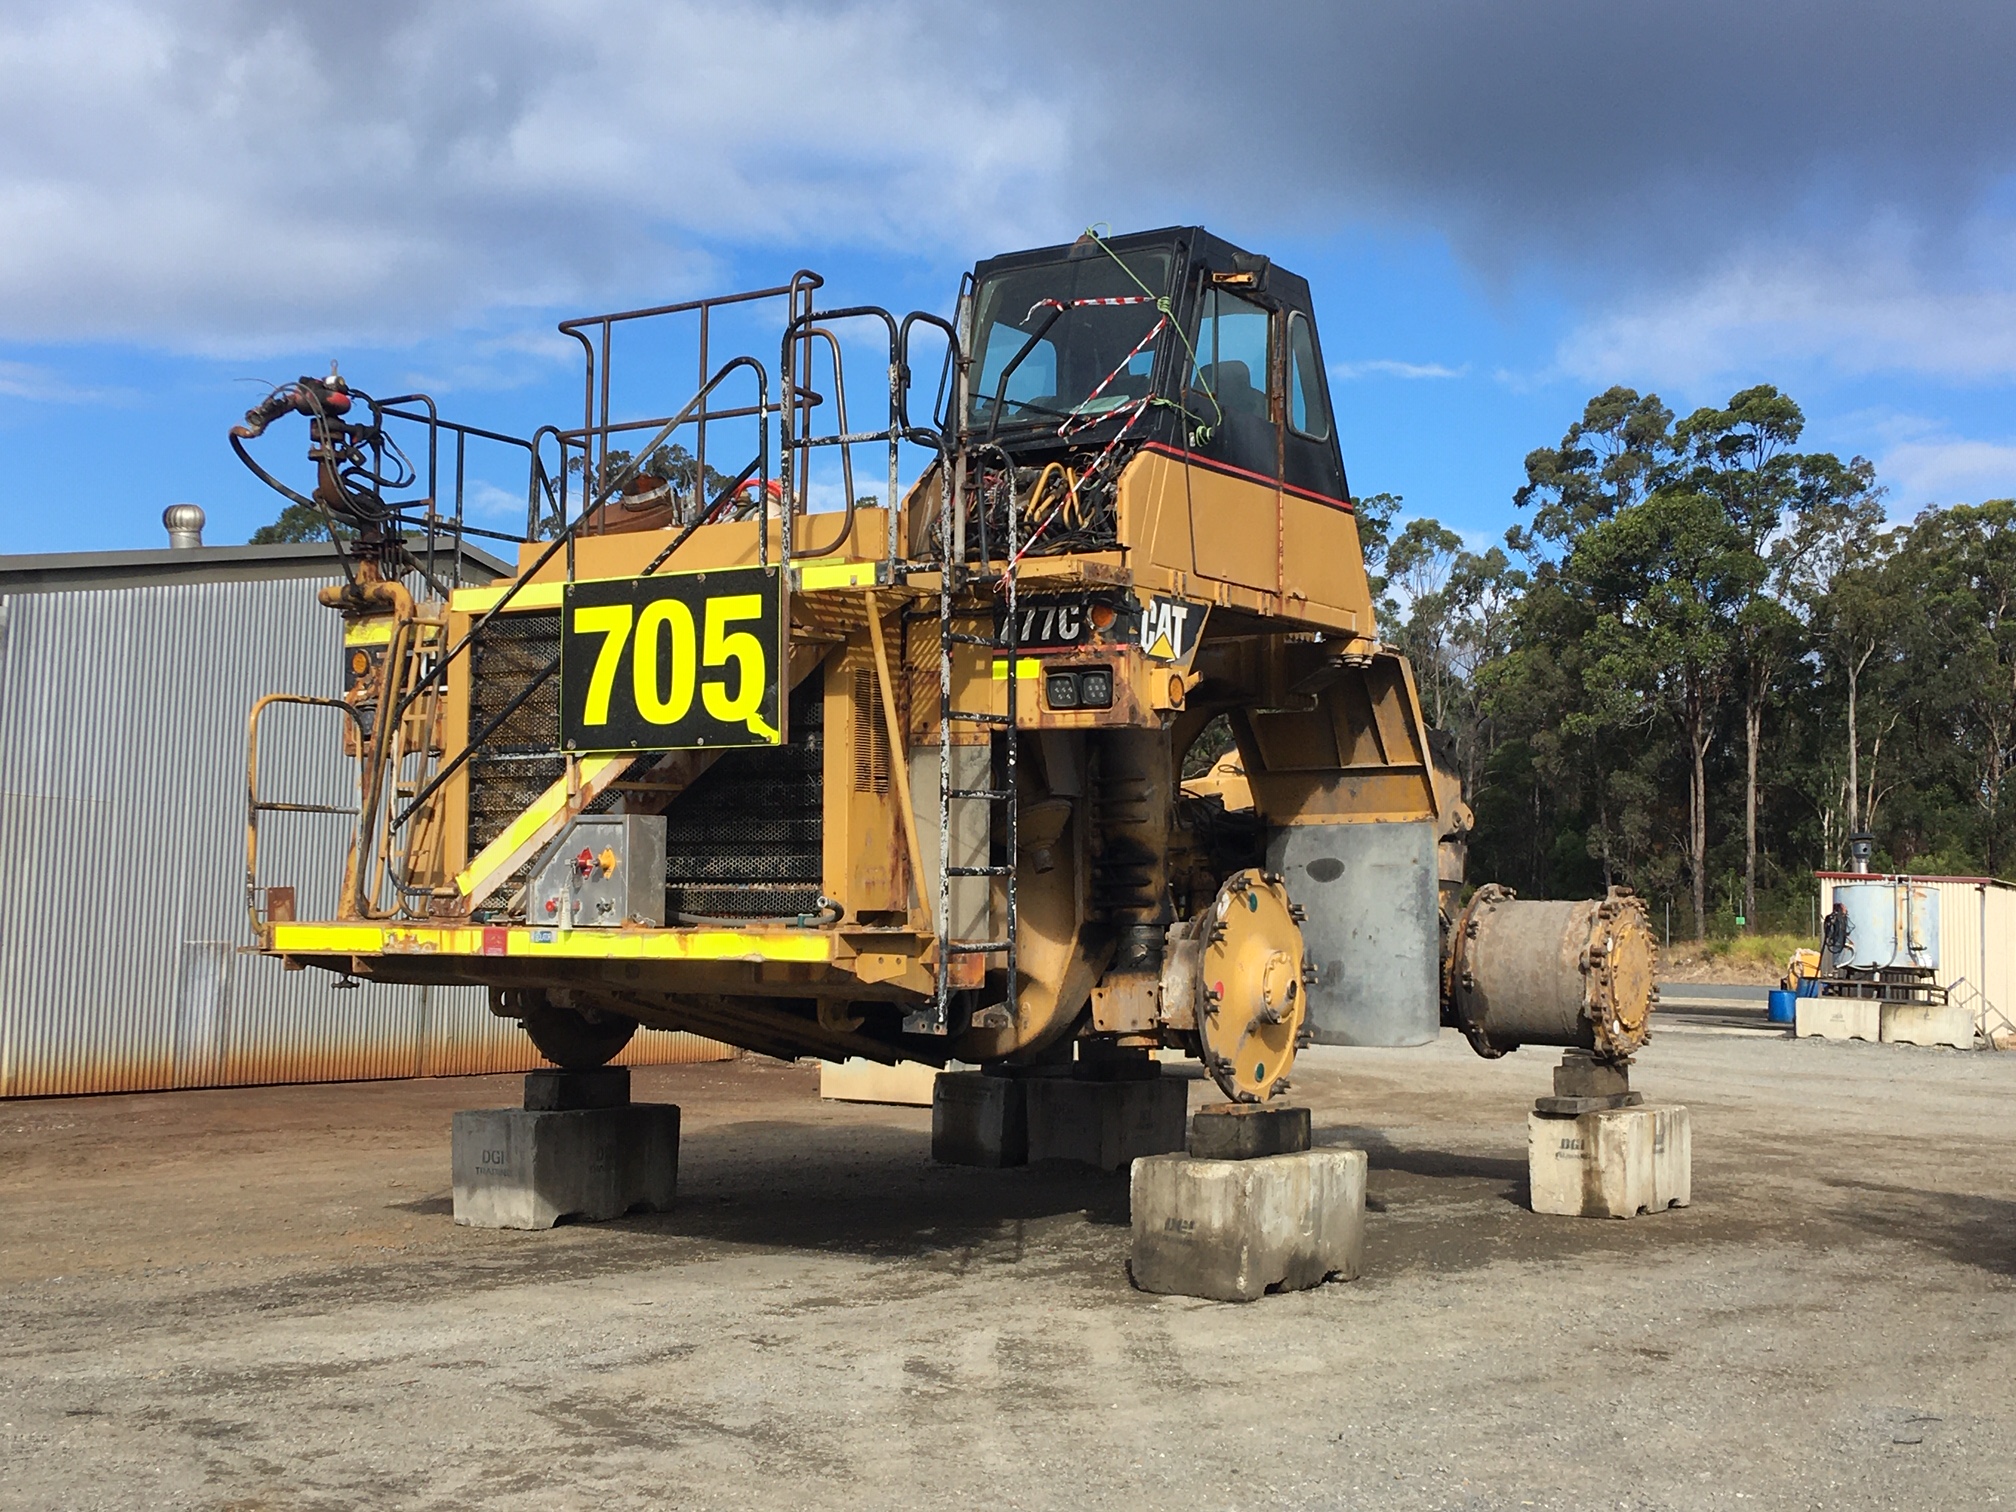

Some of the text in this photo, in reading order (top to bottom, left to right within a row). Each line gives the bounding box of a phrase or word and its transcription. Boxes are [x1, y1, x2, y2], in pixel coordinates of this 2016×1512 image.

[574, 594, 766, 725] 705
[1140, 600, 1188, 662] CAT
[482, 1149, 505, 1165] DGI
